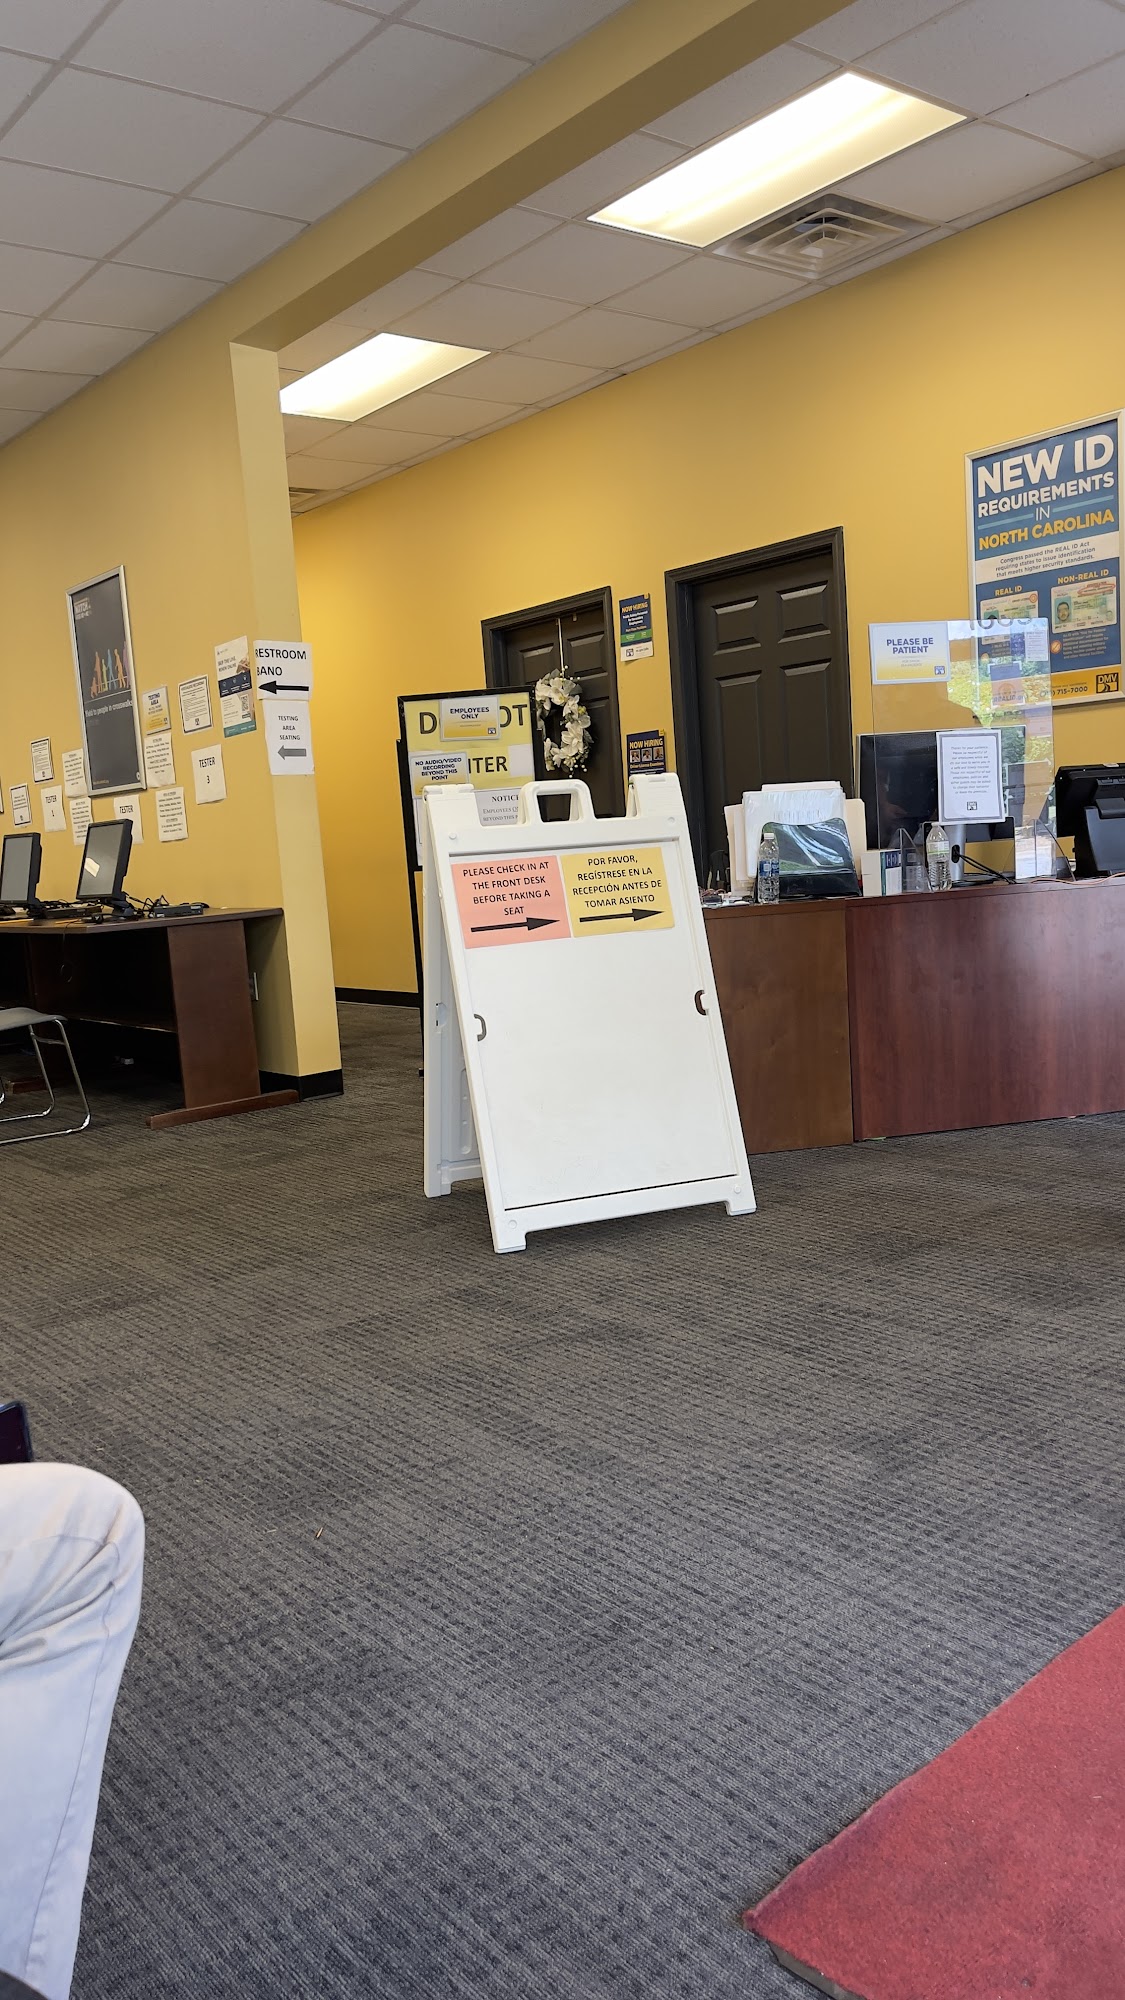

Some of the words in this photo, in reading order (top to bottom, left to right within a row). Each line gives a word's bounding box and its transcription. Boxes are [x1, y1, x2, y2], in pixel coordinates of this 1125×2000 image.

[977, 444, 1064, 498] NEW
[1074, 434, 1114, 473] ID
[978, 471, 1115, 518] REQUIREMENTS
[1035, 505, 1050, 521] IN
[979, 527, 1028, 550] NORTH
[1032, 509, 1114, 539] CAROLINA
[995, 562, 1018, 572] requiring
[1058, 547, 1096, 559] identification
[1000, 555, 1023, 565] Congress
[1025, 551, 1043, 560] passed
[1055, 545, 1070, 553] REAL
[1024, 565, 1041, 573] higher
[1042, 560, 1063, 569] security
[1065, 555, 1095, 564] standards.
[1057, 571, 1098, 584] NON-REAL
[1100, 569, 1109, 577] ID
[995, 587, 1013, 597] REAL
[1014, 585, 1022, 593] ID
[622, 605, 633, 613] NOW
[633, 602, 648, 610] HIRING
[886, 638, 920, 647] PLEASE
[922, 637, 934, 645] BE
[255, 648, 307, 660] RESTROOM
[892, 646, 929, 654] PATIENT
[1098, 673, 1118, 683] DMV
[1057, 686, 1088, 695] 715-7000
[630, 741, 643, 749] NOW
[644, 738, 663, 747] HIRING
[199, 756, 216, 768] TESTER
[425, 757, 462, 765] AUDIO/VIDEO
[206, 775, 211, 784] 3
[119, 805, 133, 813] TESTER
[587, 856, 606, 866] POR
[608, 854, 638, 866] FAVOR,
[462, 866, 495, 877] PLEASE
[496, 863, 525, 874] CHECK
[527, 862, 538, 871] IN
[539, 861, 549, 870] AT
[577, 869, 627, 882] REGÍSTRESE
[628, 868, 640, 877] EN
[641, 867, 653, 876] LA
[472, 881, 490, 890] THE
[492, 877, 521, 889] FRONT
[524, 875, 546, 885] DESK
[572, 883, 620, 896] RECEPCIÓN
[622, 881, 649, 892] ANTES
[650, 879, 662, 889] DE
[473, 894, 507, 905] BEFORE
[509, 890, 542, 901] TAKING
[544, 889, 551, 898] A
[585, 897, 618, 908] TOMAR
[619, 894, 655, 906] ASIENTO
[504, 906, 525, 916] SEAT
